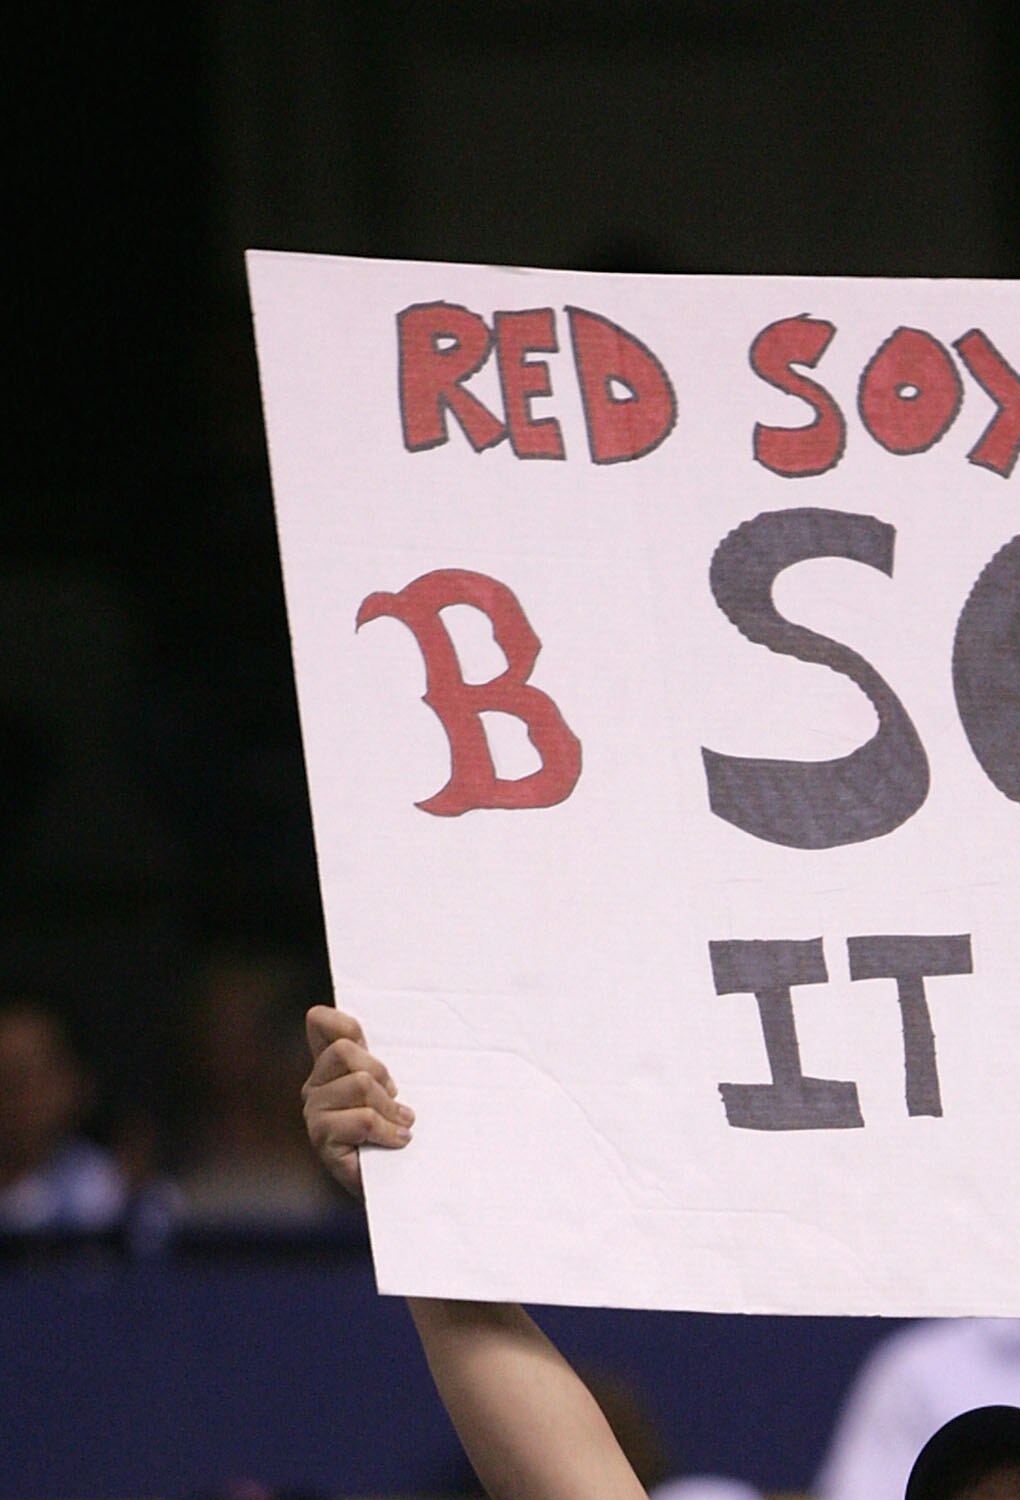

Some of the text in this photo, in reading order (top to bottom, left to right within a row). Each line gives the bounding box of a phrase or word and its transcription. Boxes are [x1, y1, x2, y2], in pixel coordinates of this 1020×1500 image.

[396, 300, 678, 465] RED
[355, 567, 583, 818] B
[708, 933, 974, 1131] IT
